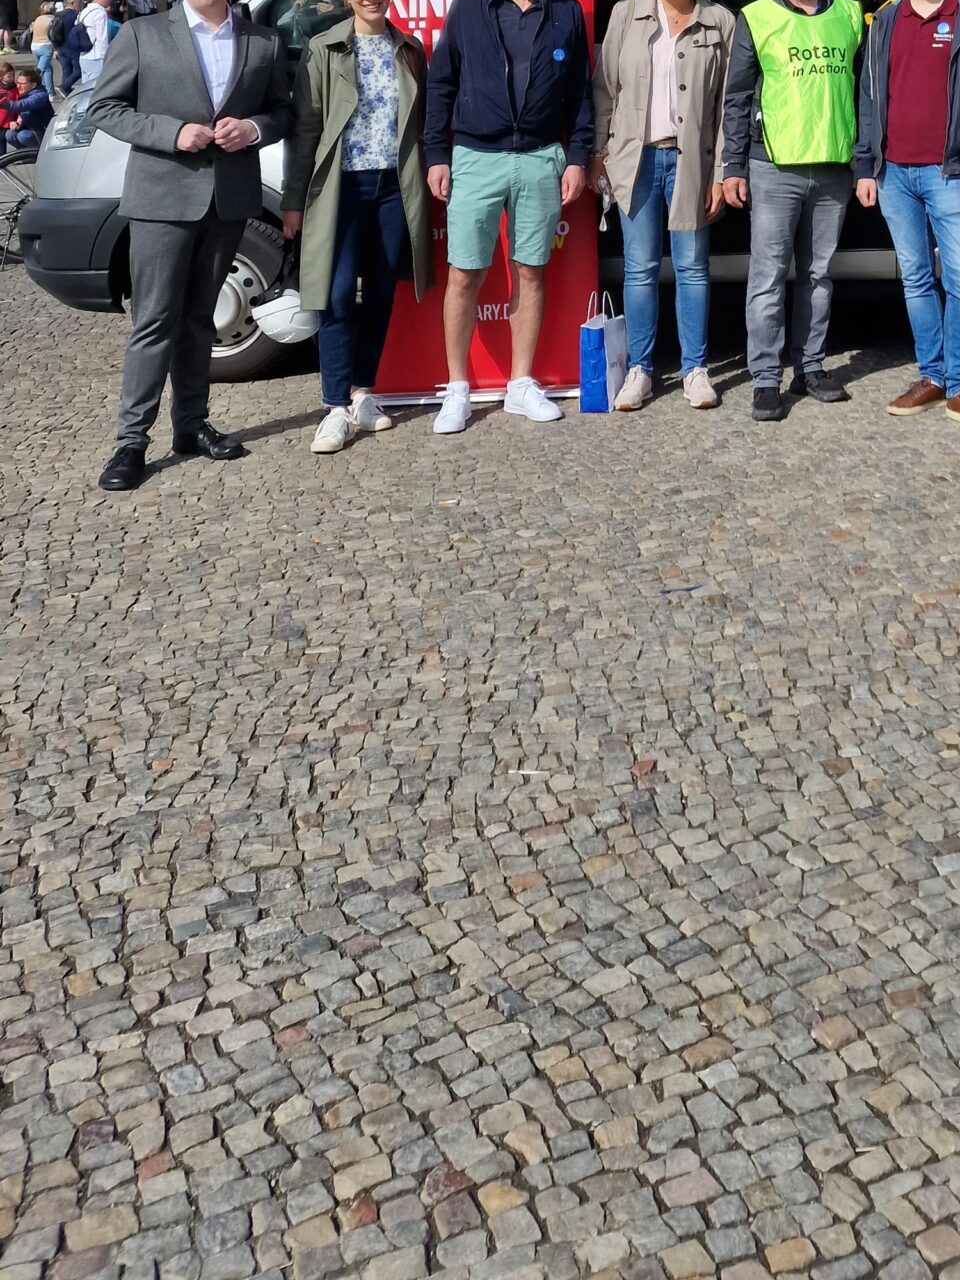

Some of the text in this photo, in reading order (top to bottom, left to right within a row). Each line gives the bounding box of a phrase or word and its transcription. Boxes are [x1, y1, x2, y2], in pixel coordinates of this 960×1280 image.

[788, 45, 846, 63] Rotary
[792, 62, 847, 77] in Action
